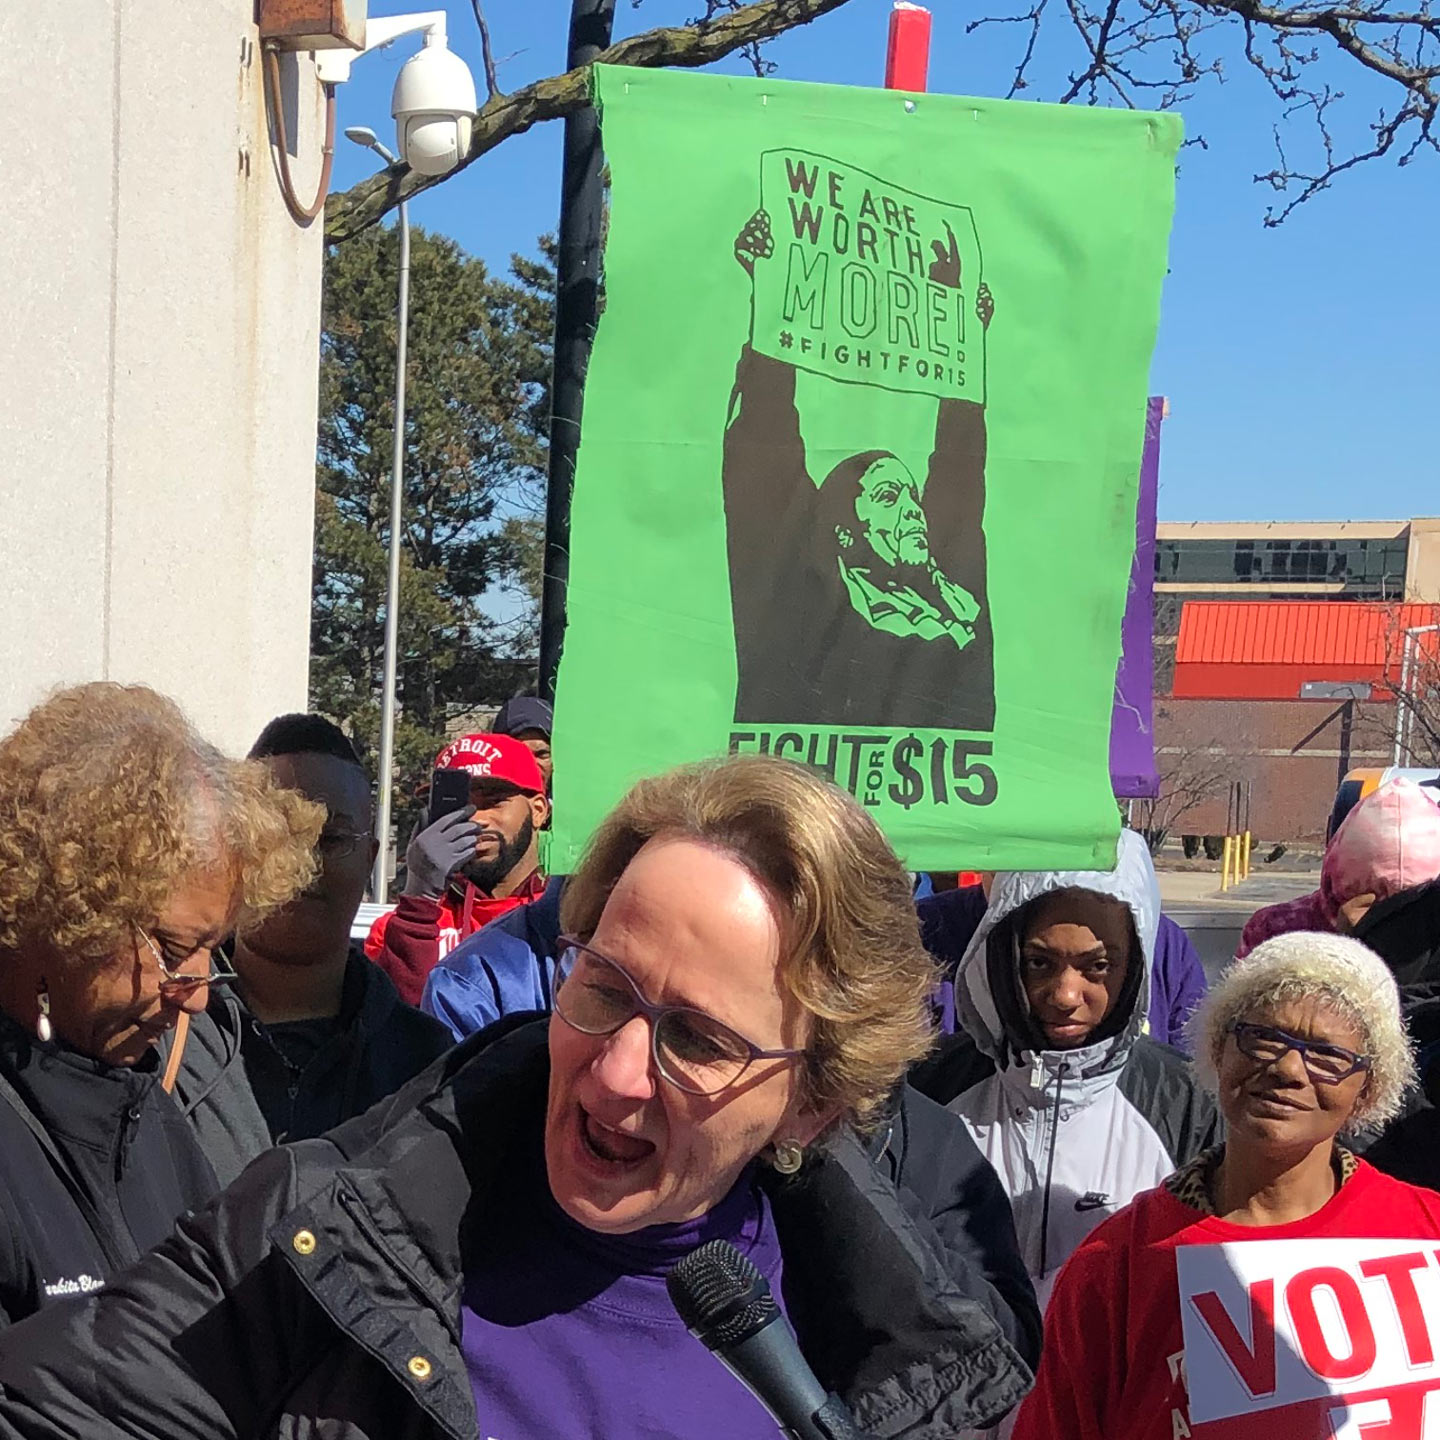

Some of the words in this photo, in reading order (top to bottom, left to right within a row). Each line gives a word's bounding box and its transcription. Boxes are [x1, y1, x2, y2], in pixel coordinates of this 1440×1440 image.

[785, 157, 845, 211] WE
[859, 188, 921, 236] ARE
[787, 197, 925, 278] WORTH
[783, 243, 965, 363] MORE!
[778, 330, 966, 387] #FIGHTFOR15
[863, 749, 886, 806] FOR
[887, 732, 998, 810] $15
[1190, 1248, 1440, 1398] VOT
